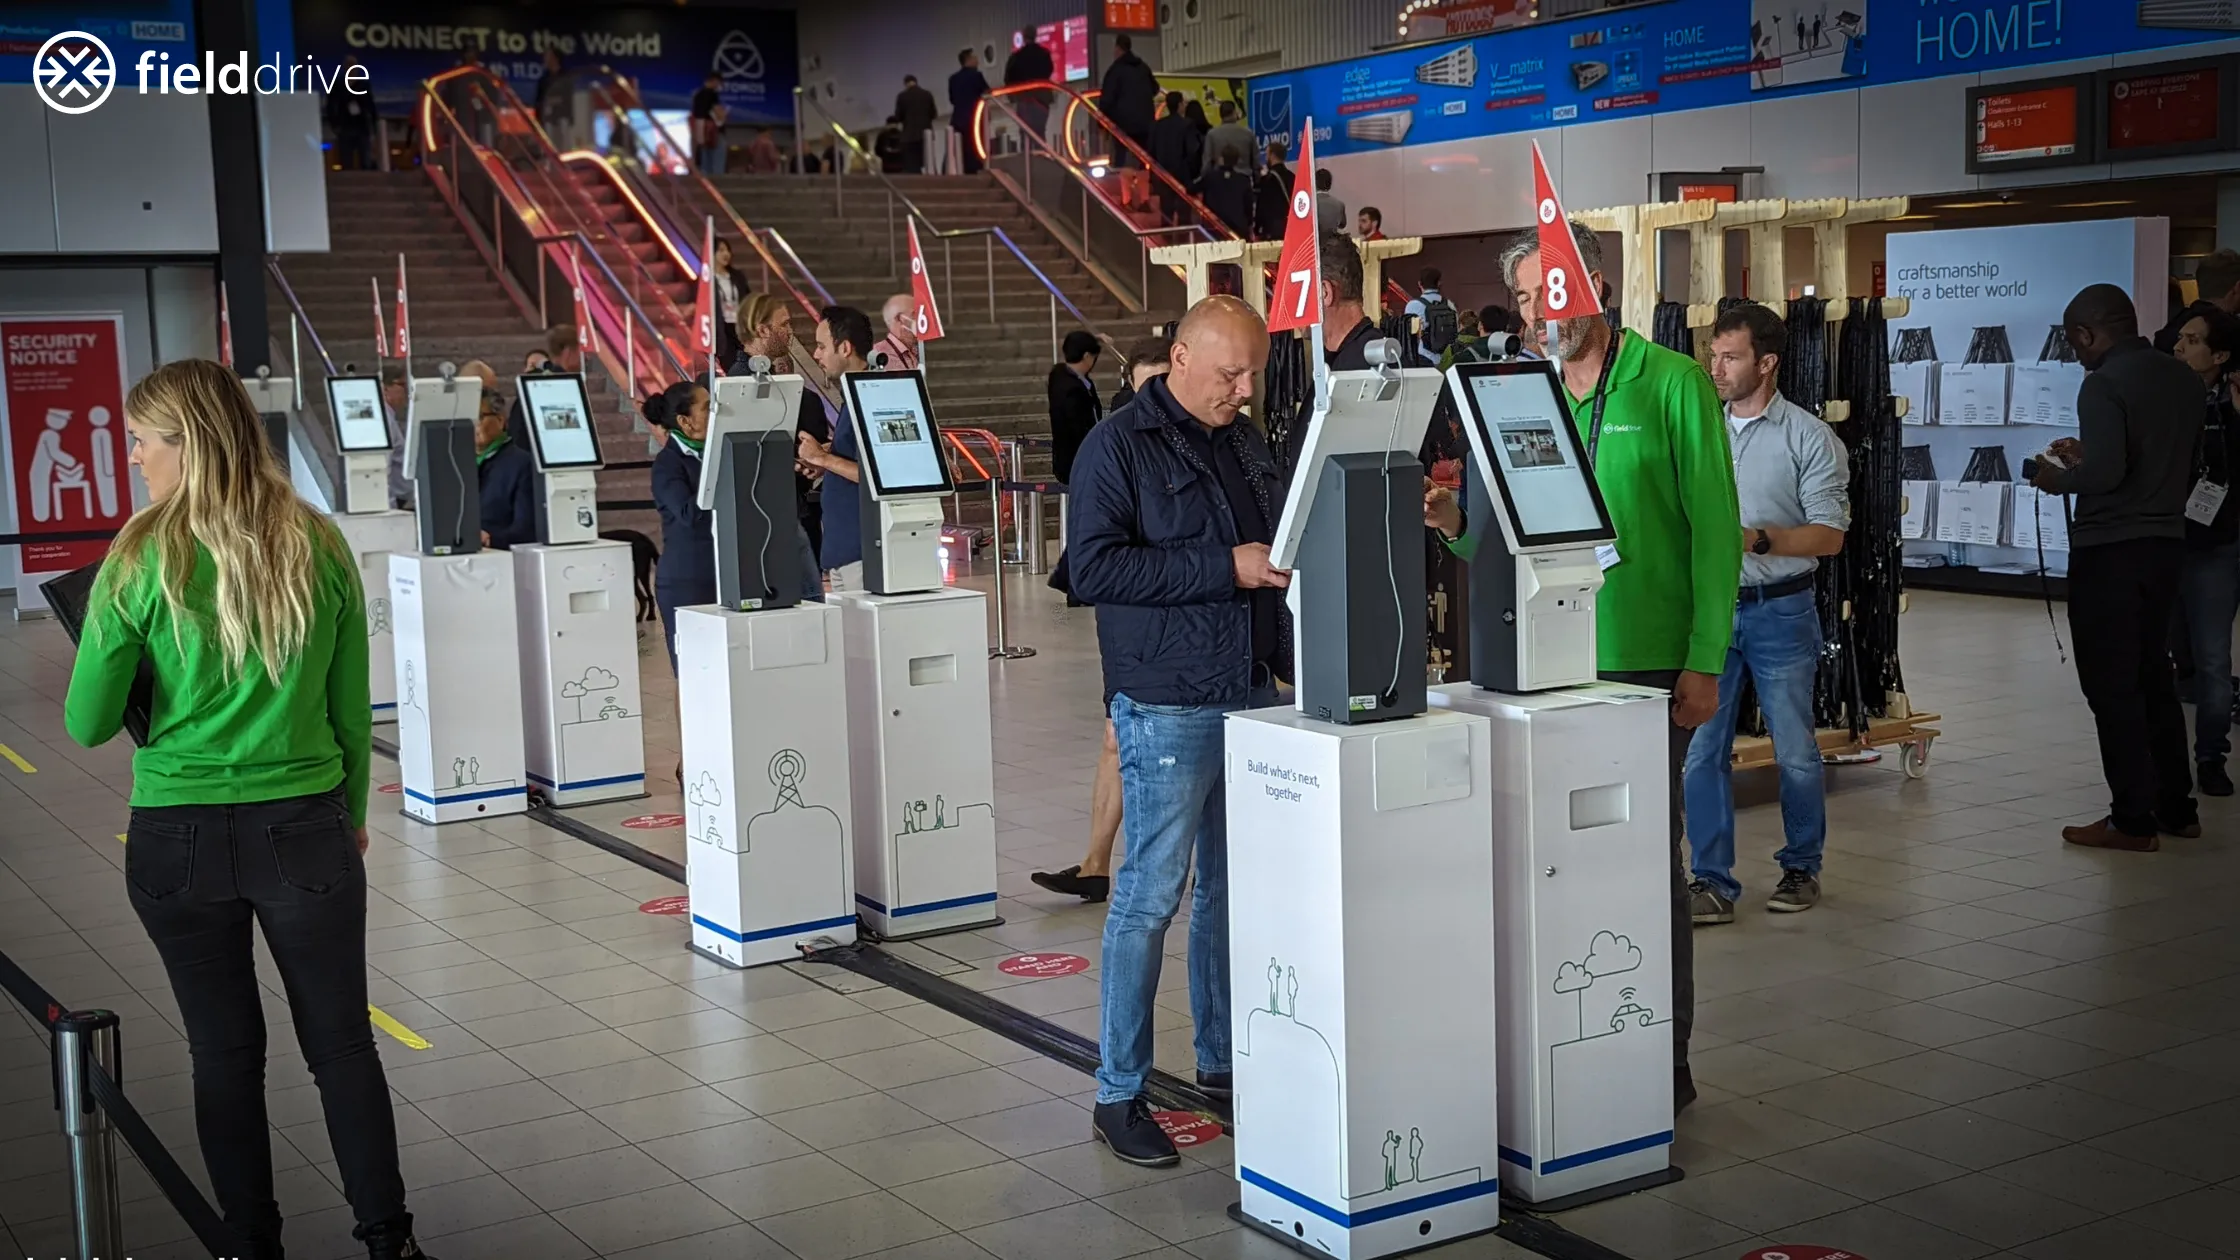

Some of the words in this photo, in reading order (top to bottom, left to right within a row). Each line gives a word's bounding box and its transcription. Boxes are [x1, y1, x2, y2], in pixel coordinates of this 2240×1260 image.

[135, 25, 182, 38] HOME
[346, 22, 490, 52] CONNECT
[497, 30, 523, 53] to
[533, 30, 575, 54] the
[579, 32, 661, 57] World
[1664, 26, 1705, 48] HOME
[1917, 0, 2062, 64] HOME!
[1444, 103, 1464, 114] HOME
[1594, 99, 1611, 110] NEW
[1987, 97, 2012, 107] Toilets
[1554, 106, 1576, 118] HOME
[1987, 120, 2005, 130] Halls
[2006, 118, 2022, 129] 1-13
[1256, 132, 1290, 149] LAWO
[1897, 261, 2000, 280] craftsmanship
[1289, 268, 1313, 320] 7
[1546, 267, 1568, 311] 8
[1898, 285, 1918, 300] for
[1921, 287, 1931, 300] a
[1936, 283, 1981, 300] better
[1984, 280, 2028, 297] world
[917, 304, 928, 334] 6
[399, 328, 408, 353] 3
[579, 324, 588, 345] 4
[700, 316, 710, 347] 5
[8, 333, 98, 350] SECURITY
[10, 350, 78, 366] NOTICE
[1247, 759, 1268, 775] Build
[1269, 765, 1297, 782] what's
[1298, 773, 1320, 789] next,
[1265, 783, 1302, 802] together
[1164, 1118, 1212, 1134] STAND
